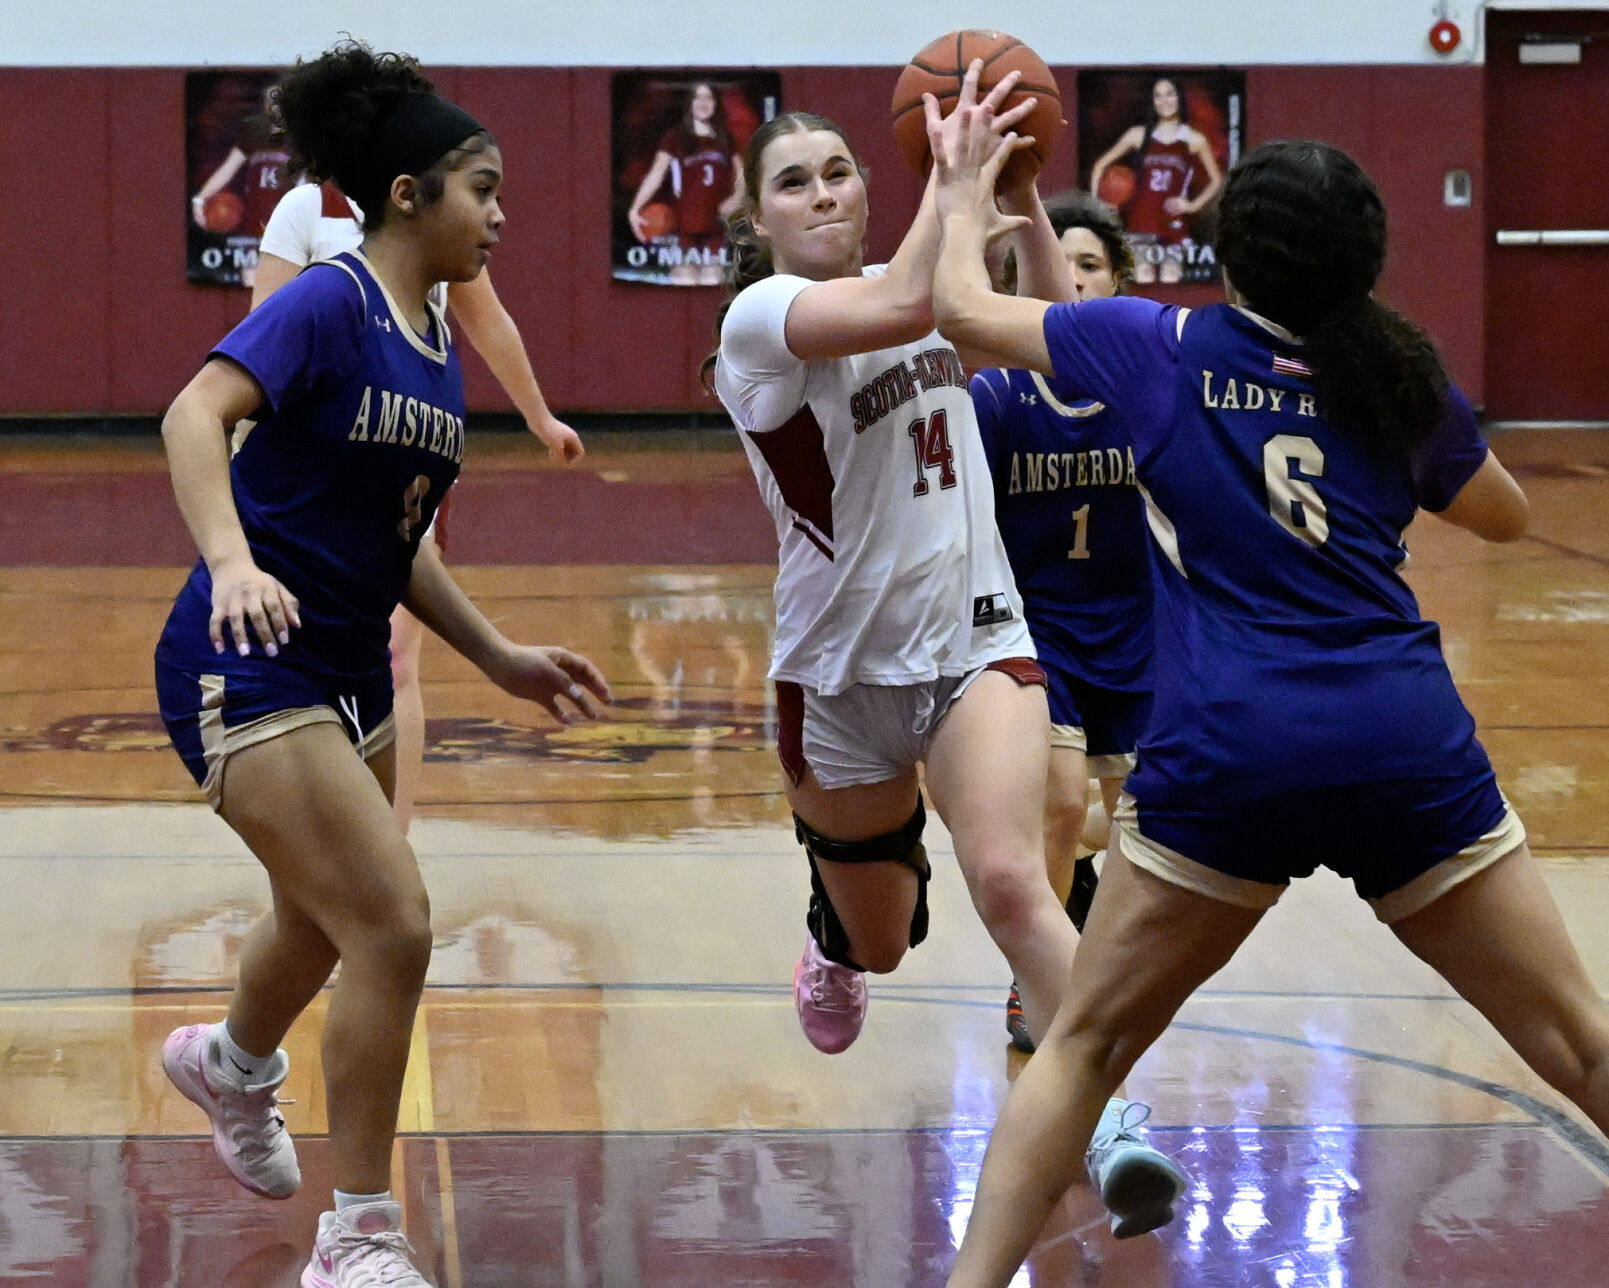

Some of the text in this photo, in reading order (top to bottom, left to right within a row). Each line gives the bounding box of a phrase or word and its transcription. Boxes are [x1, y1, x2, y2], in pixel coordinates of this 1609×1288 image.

[1202, 370, 1286, 411] LADY
[908, 408, 957, 498] 14
[1008, 446, 1136, 495] AMSTERDA
[1263, 434, 1329, 548] 6
[1067, 503, 1091, 559] 1
